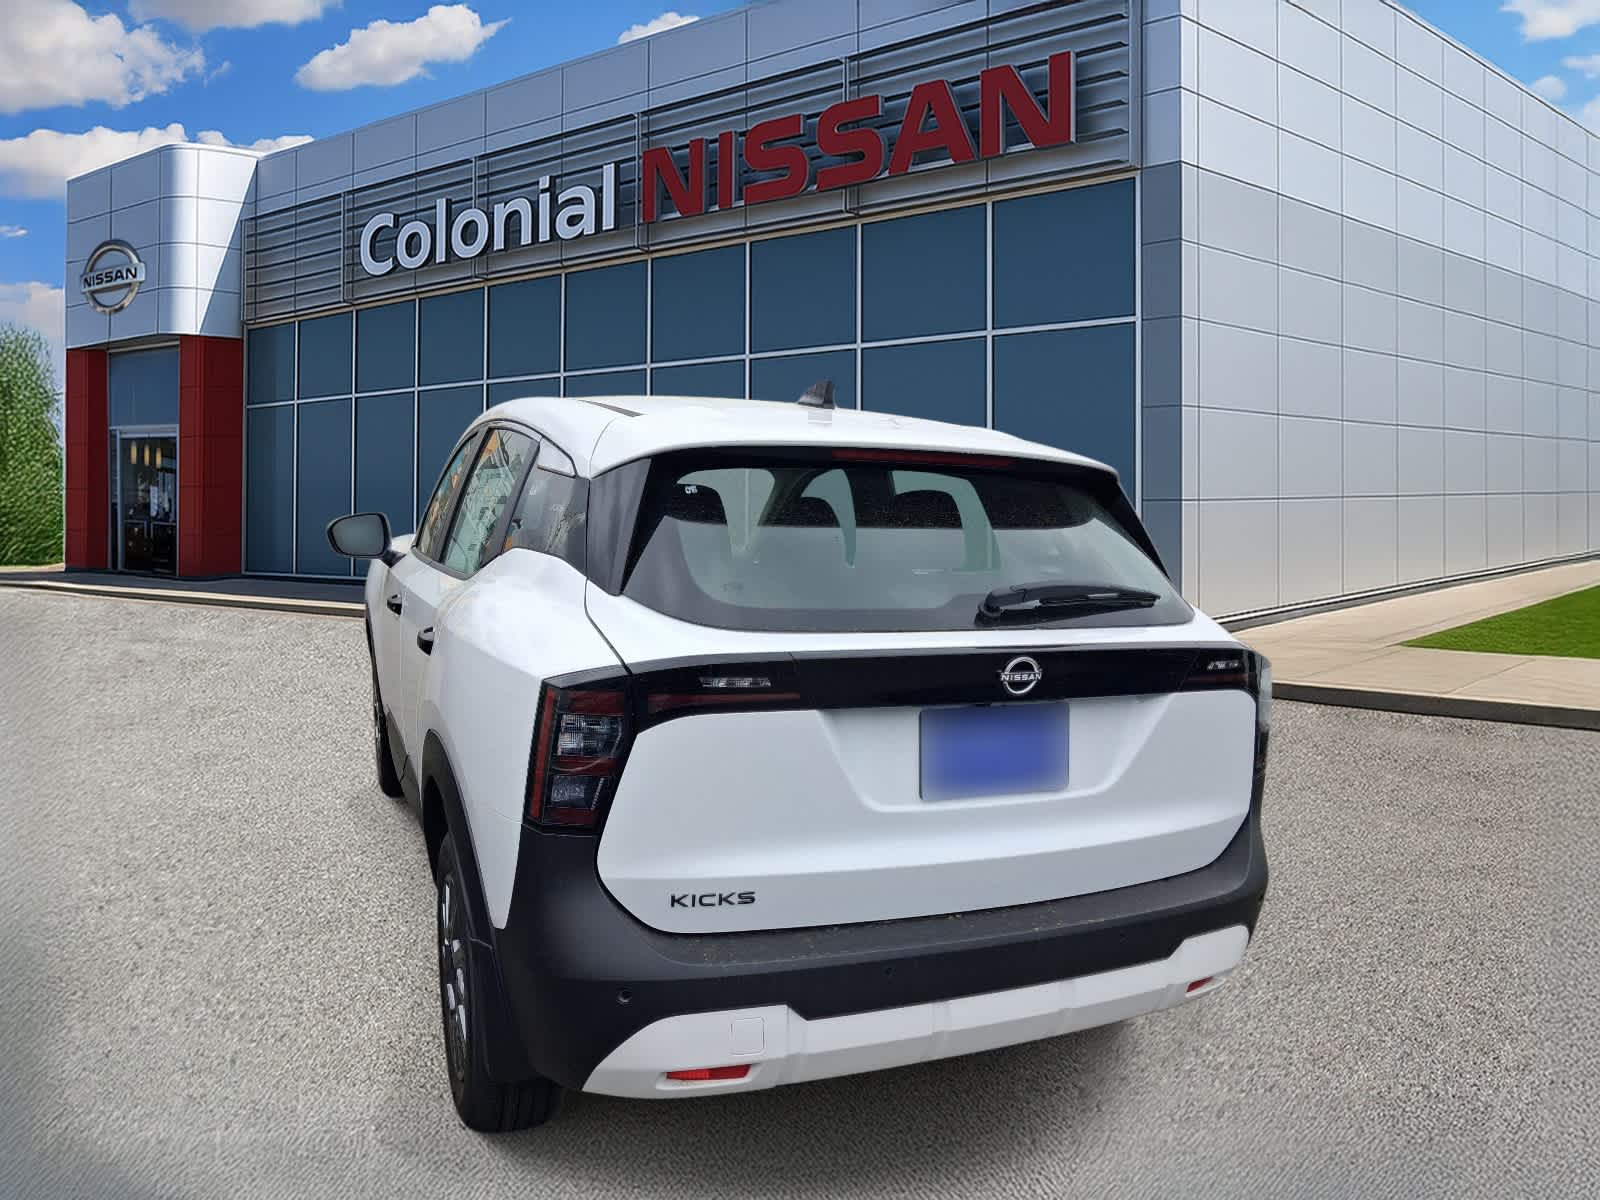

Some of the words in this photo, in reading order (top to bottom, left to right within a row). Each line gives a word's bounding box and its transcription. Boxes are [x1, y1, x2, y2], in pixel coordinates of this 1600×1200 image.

[359, 162, 617, 277] Colonial
[641, 50, 1077, 222] NISSAN
[83, 266, 138, 289] NISSAN
[1001, 673, 1042, 681] NISSAN
[670, 891, 756, 908] KICKS
